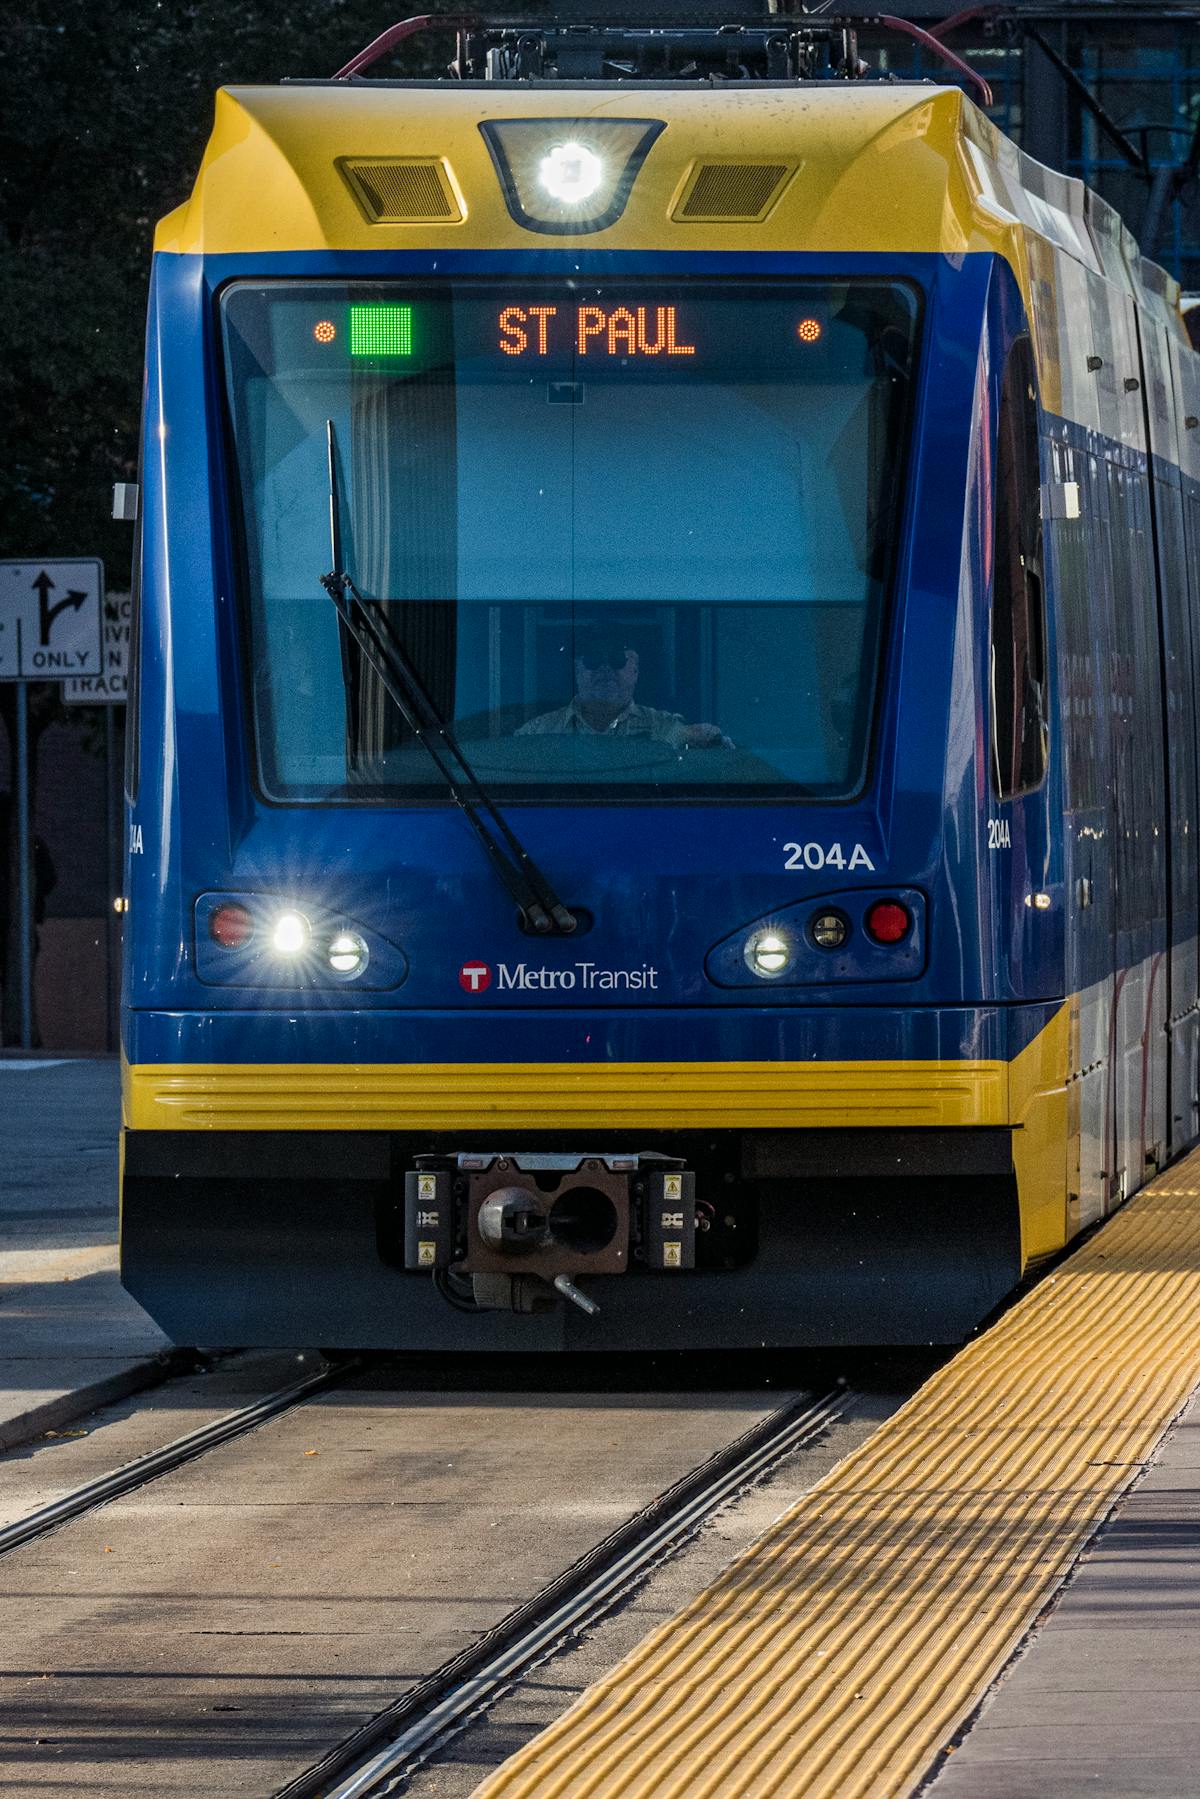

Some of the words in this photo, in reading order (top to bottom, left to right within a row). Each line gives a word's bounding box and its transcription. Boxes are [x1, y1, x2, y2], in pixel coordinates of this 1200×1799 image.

[499, 307, 557, 355] ST
[578, 307, 695, 355] PAUL
[33, 651, 89, 668] ONLY
[987, 818, 1011, 849] 204A
[782, 842, 876, 871] 204A
